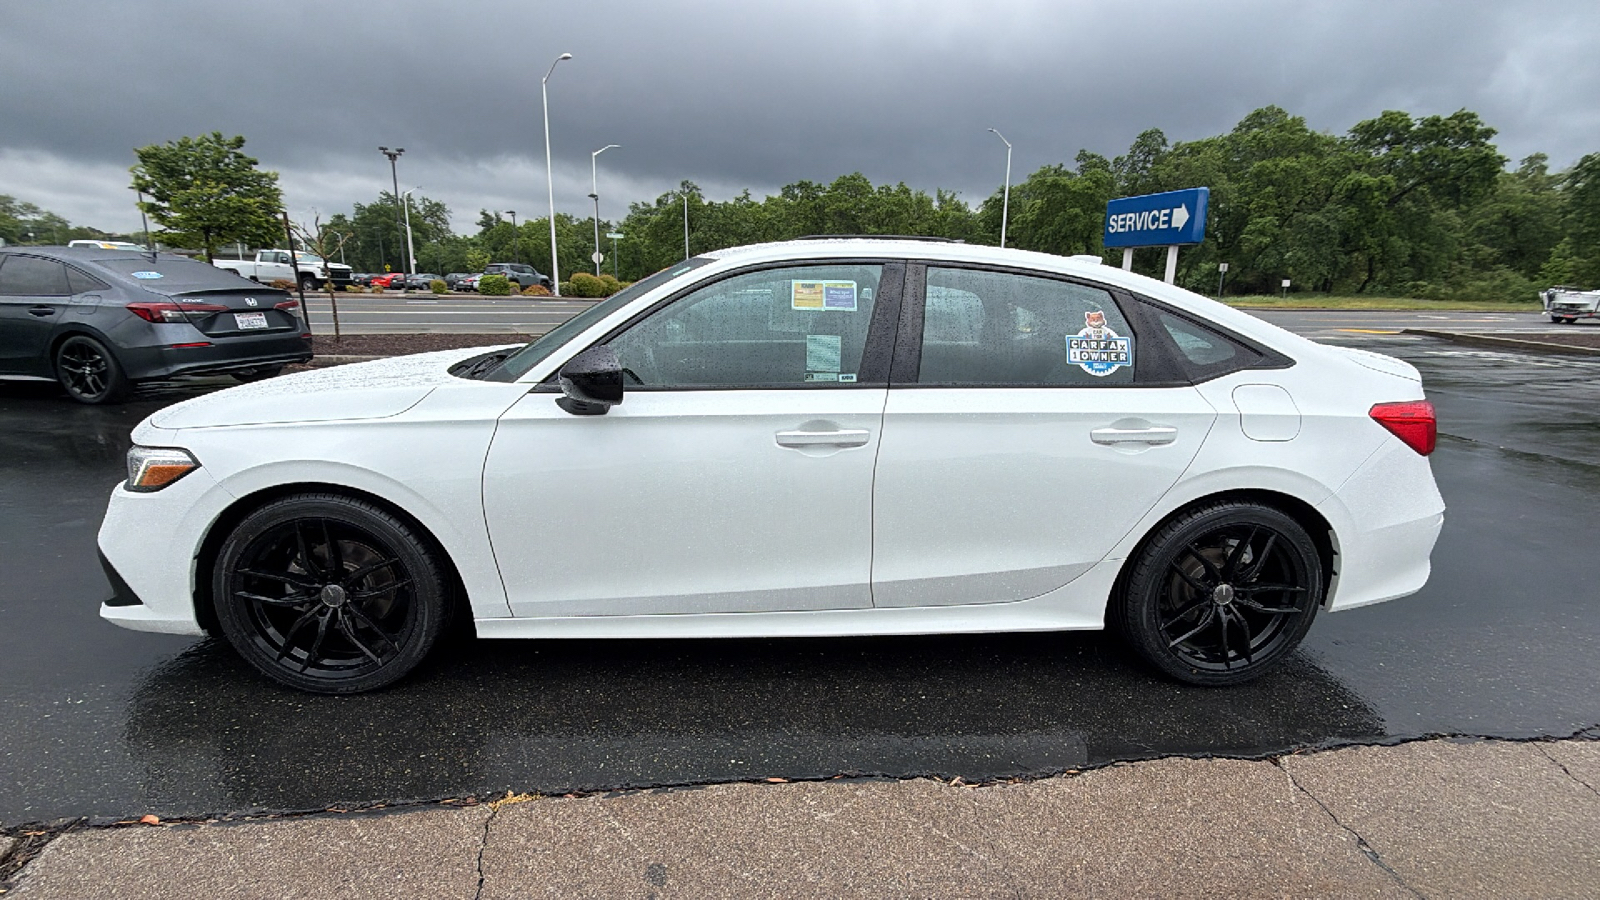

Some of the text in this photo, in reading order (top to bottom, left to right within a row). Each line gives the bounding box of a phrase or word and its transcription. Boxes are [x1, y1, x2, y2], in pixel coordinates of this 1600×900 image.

[1108, 208, 1170, 233] SERVICE
[1070, 340, 1126, 351] CARFAX
[1081, 352, 1127, 361] OWNER
